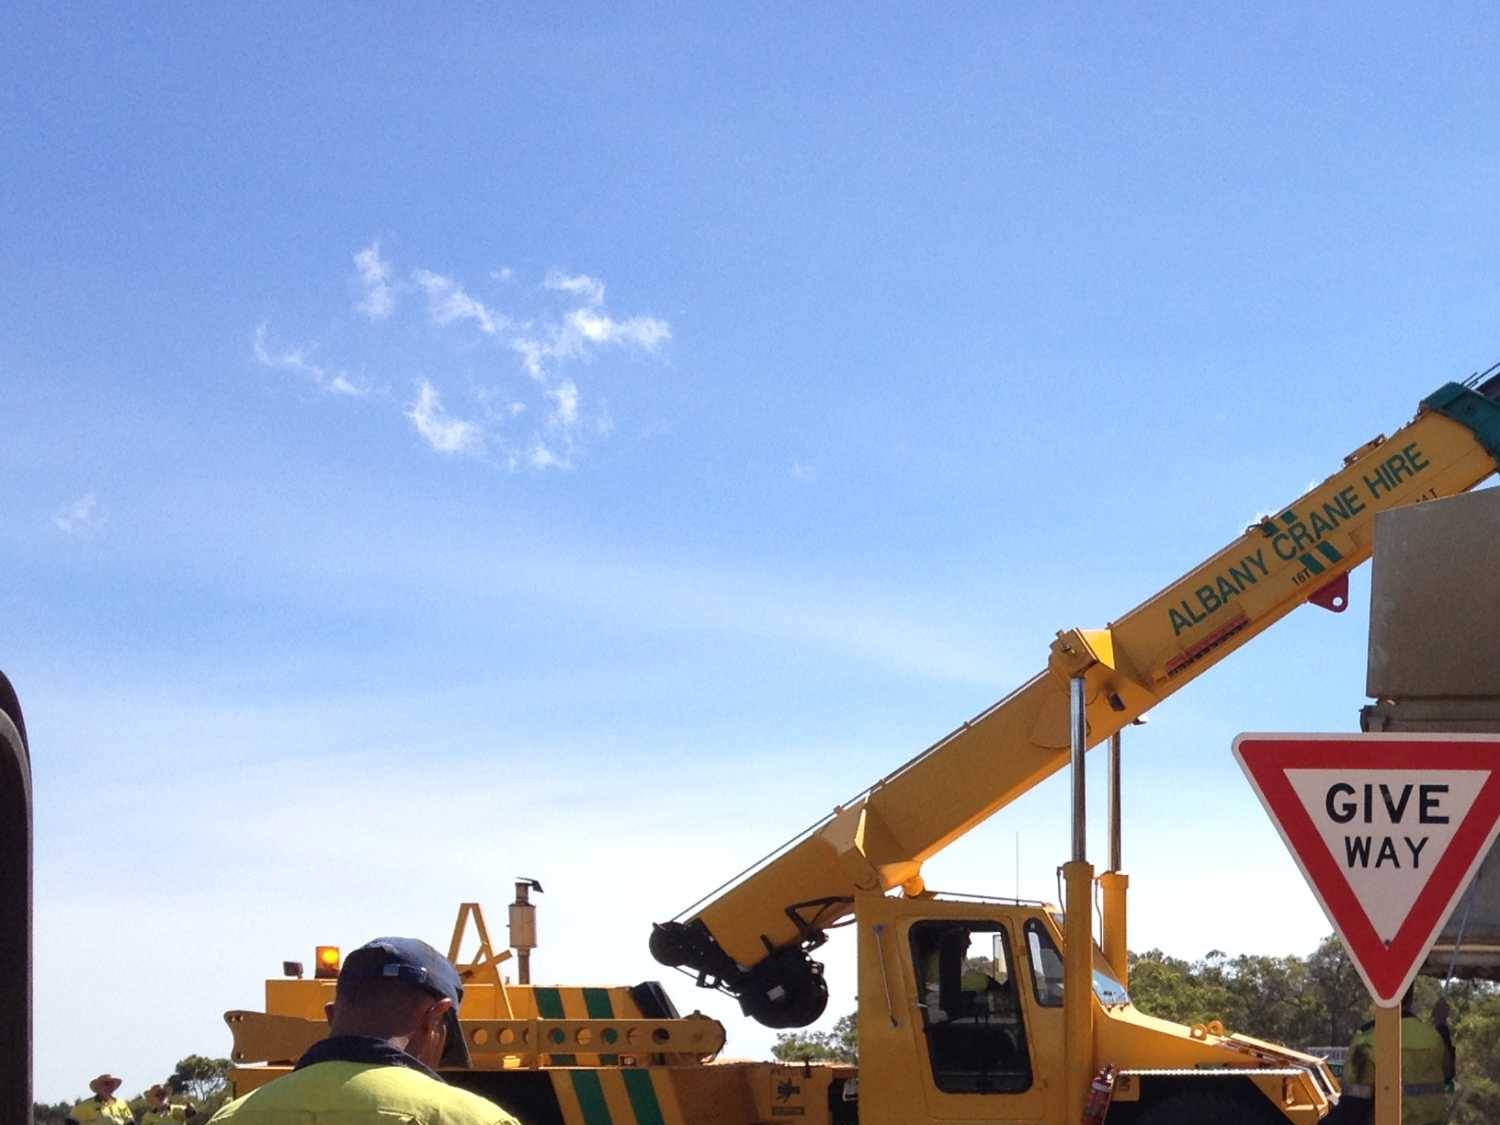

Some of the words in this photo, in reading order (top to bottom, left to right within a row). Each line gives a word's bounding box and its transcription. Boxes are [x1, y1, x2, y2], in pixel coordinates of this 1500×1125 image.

[1168, 549, 1269, 636] ALBANY
[1271, 486, 1366, 561] CRANE
[1362, 443, 1430, 499] HIRE
[1326, 783, 1449, 824] GIVE
[1344, 836, 1429, 869] WAY
